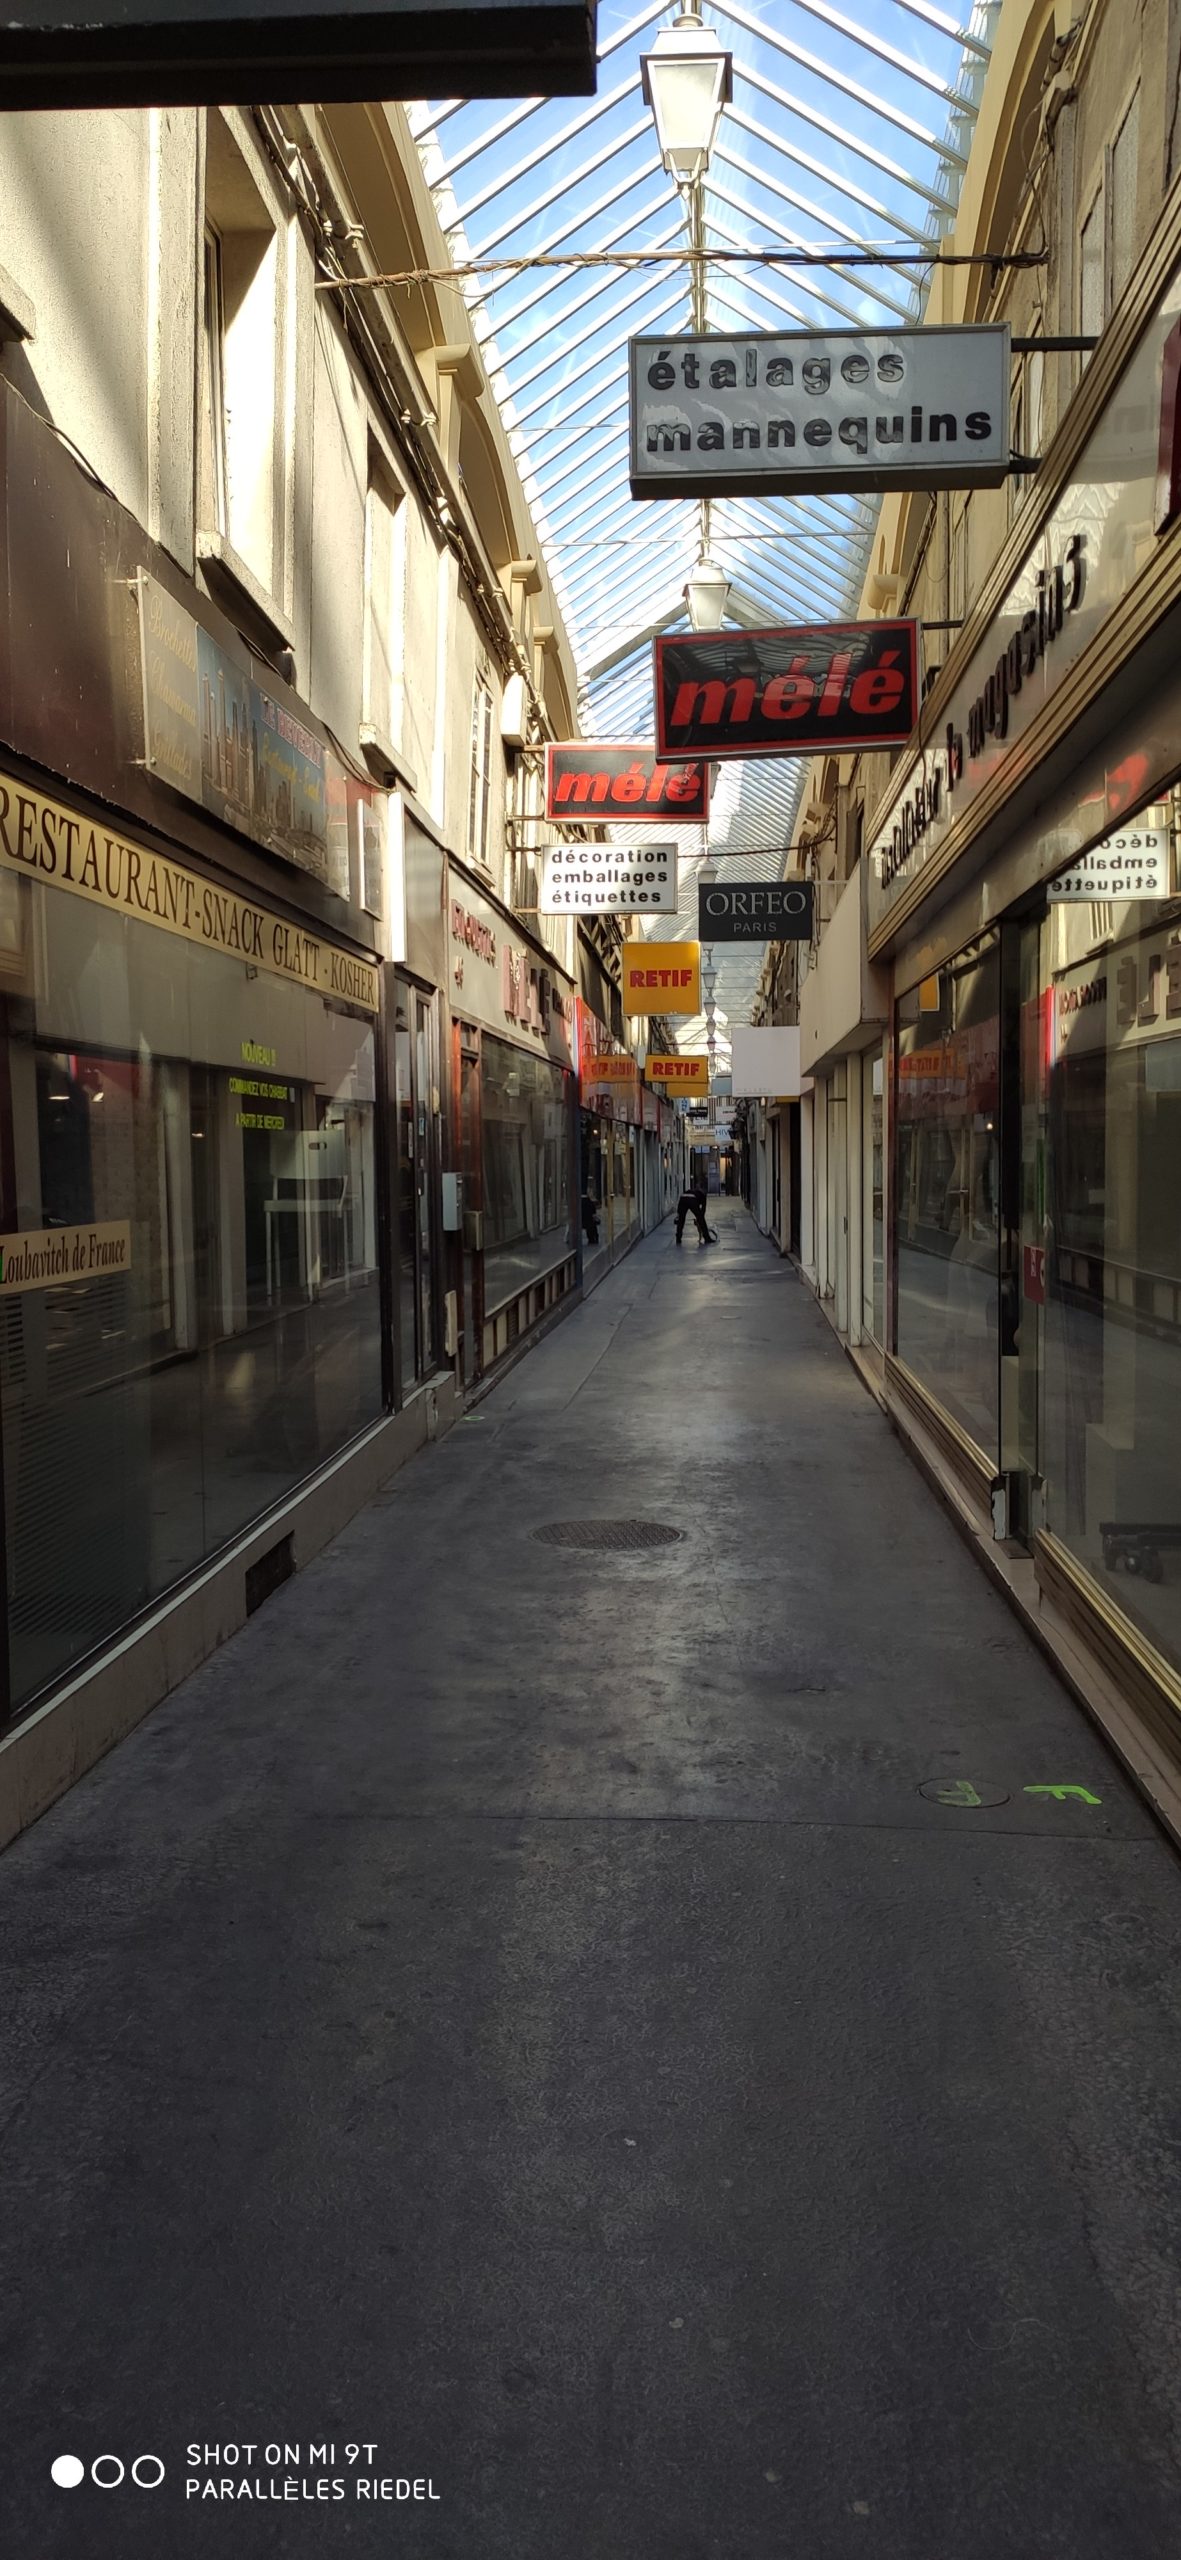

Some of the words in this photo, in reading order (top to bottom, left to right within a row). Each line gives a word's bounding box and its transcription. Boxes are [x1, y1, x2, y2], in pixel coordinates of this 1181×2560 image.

[647, 348, 904, 395] étalages
[646, 406, 993, 454] mannequins
[966, 533, 1084, 760] magasins
[670, 650, 905, 727] mélé
[555, 761, 701, 804] mélé
[551, 849, 668, 864] décoration
[551, 869, 668, 886] emballages
[551, 889, 661, 907] étiquettes
[705, 890, 807, 916] ORFEO
[733, 921, 778, 933] PARIS
[272, 923, 321, 982] GLATT
[330, 952, 375, 1005] KOSHER
[629, 969, 693, 988] RETIF
[652, 1061, 700, 1077] RETIF
[71, 1233, 86, 1272] de
[87, 1233, 126, 1269] France
